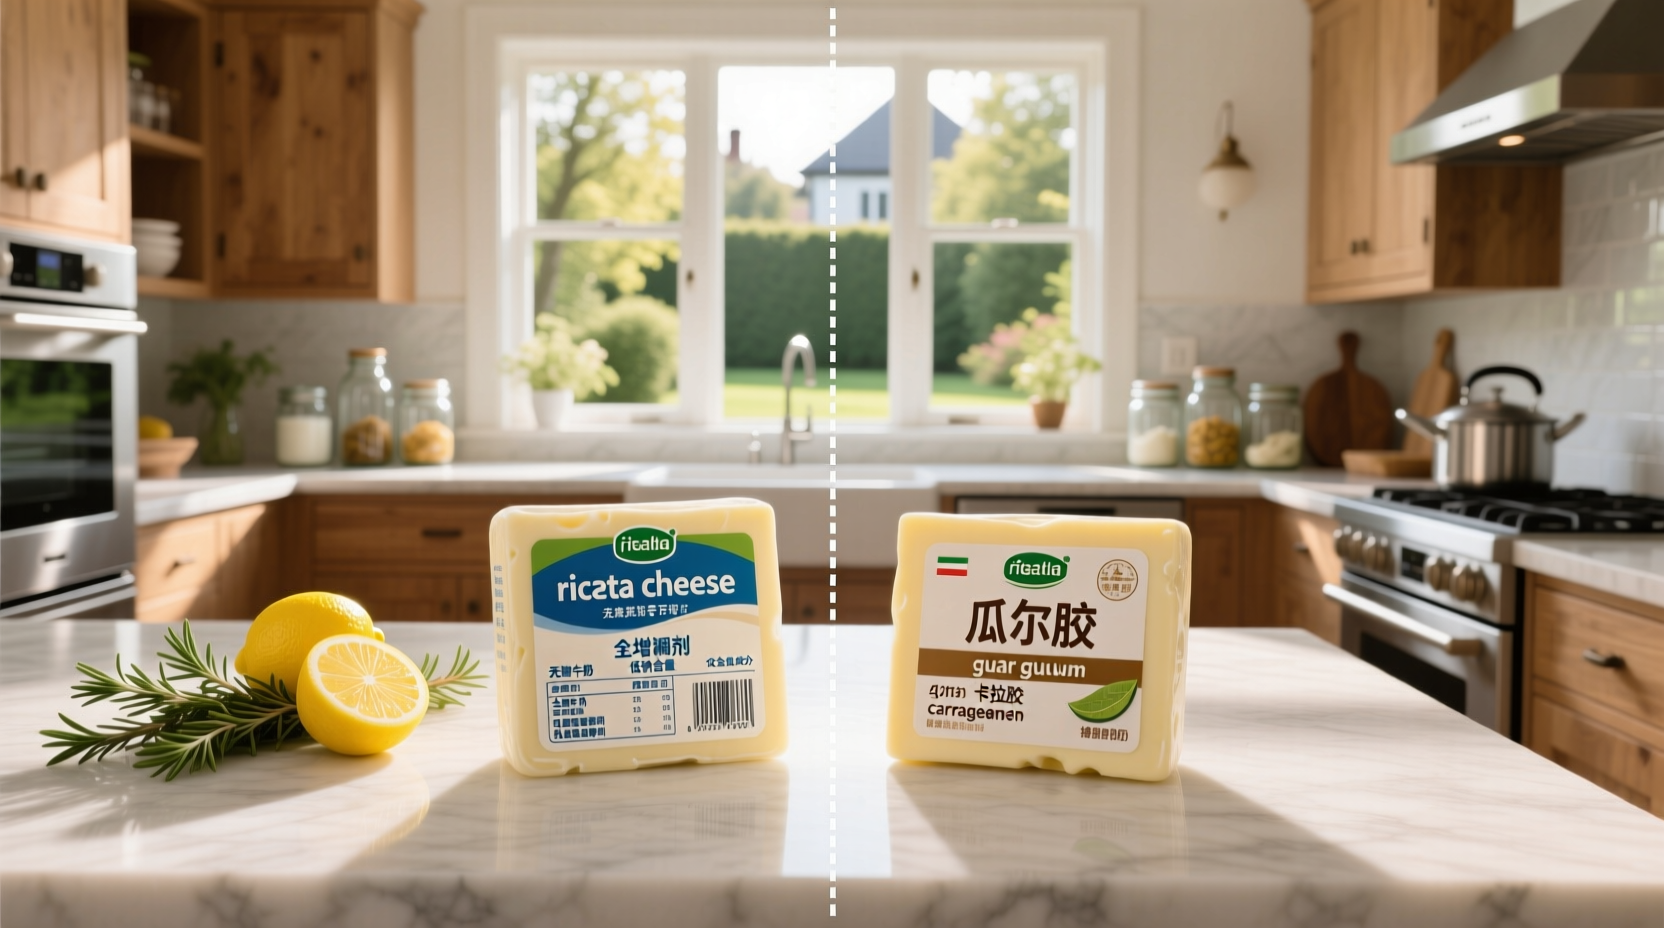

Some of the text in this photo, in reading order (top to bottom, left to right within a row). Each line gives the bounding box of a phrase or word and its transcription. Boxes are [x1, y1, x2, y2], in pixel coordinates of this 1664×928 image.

[641, 569, 736, 597] cheese
[965, 598, 1097, 650] 瓜尔胶
[972, 658, 1016, 678] guar
